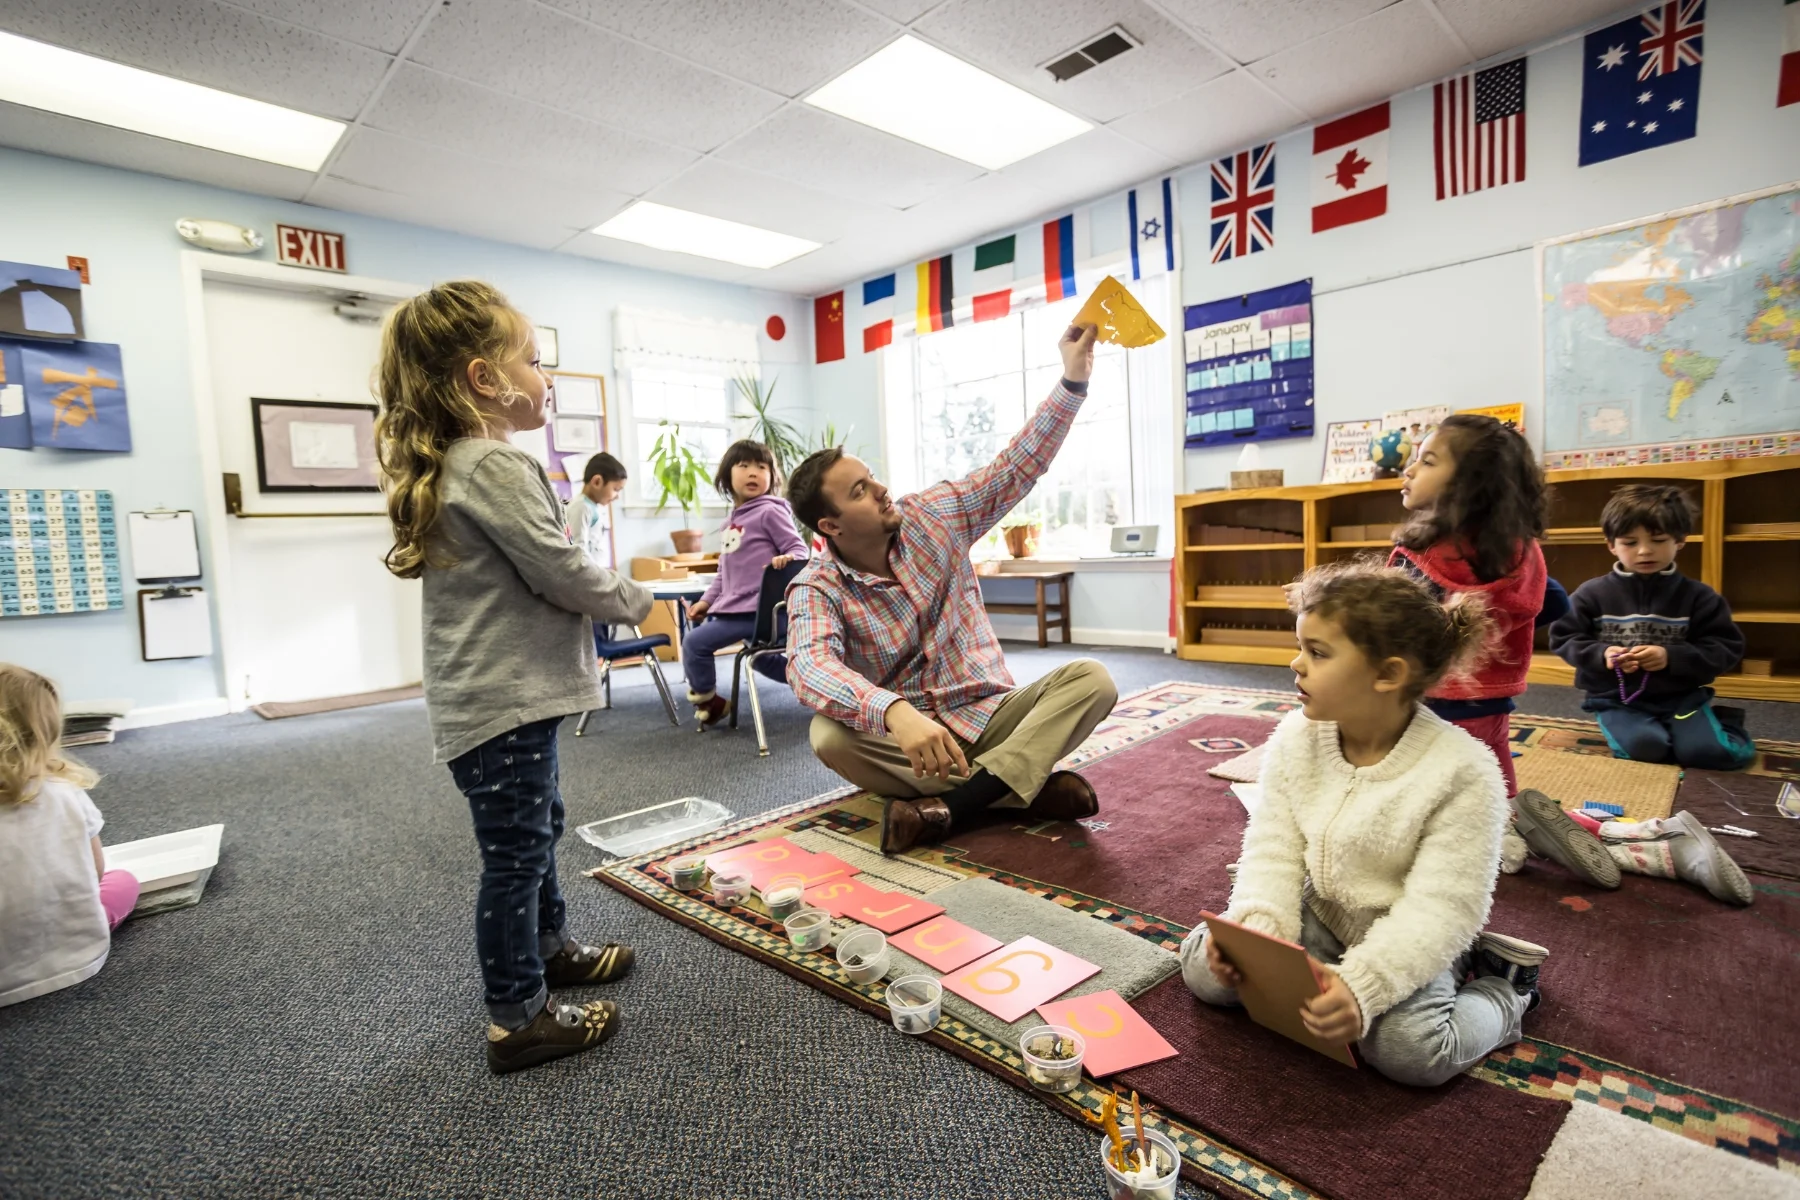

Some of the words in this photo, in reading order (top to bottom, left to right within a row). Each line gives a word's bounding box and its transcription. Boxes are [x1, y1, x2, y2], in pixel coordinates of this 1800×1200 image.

[279, 226, 341, 270] EXIT
[1204, 322, 1251, 340] January
[1332, 429, 1373, 439] Children
